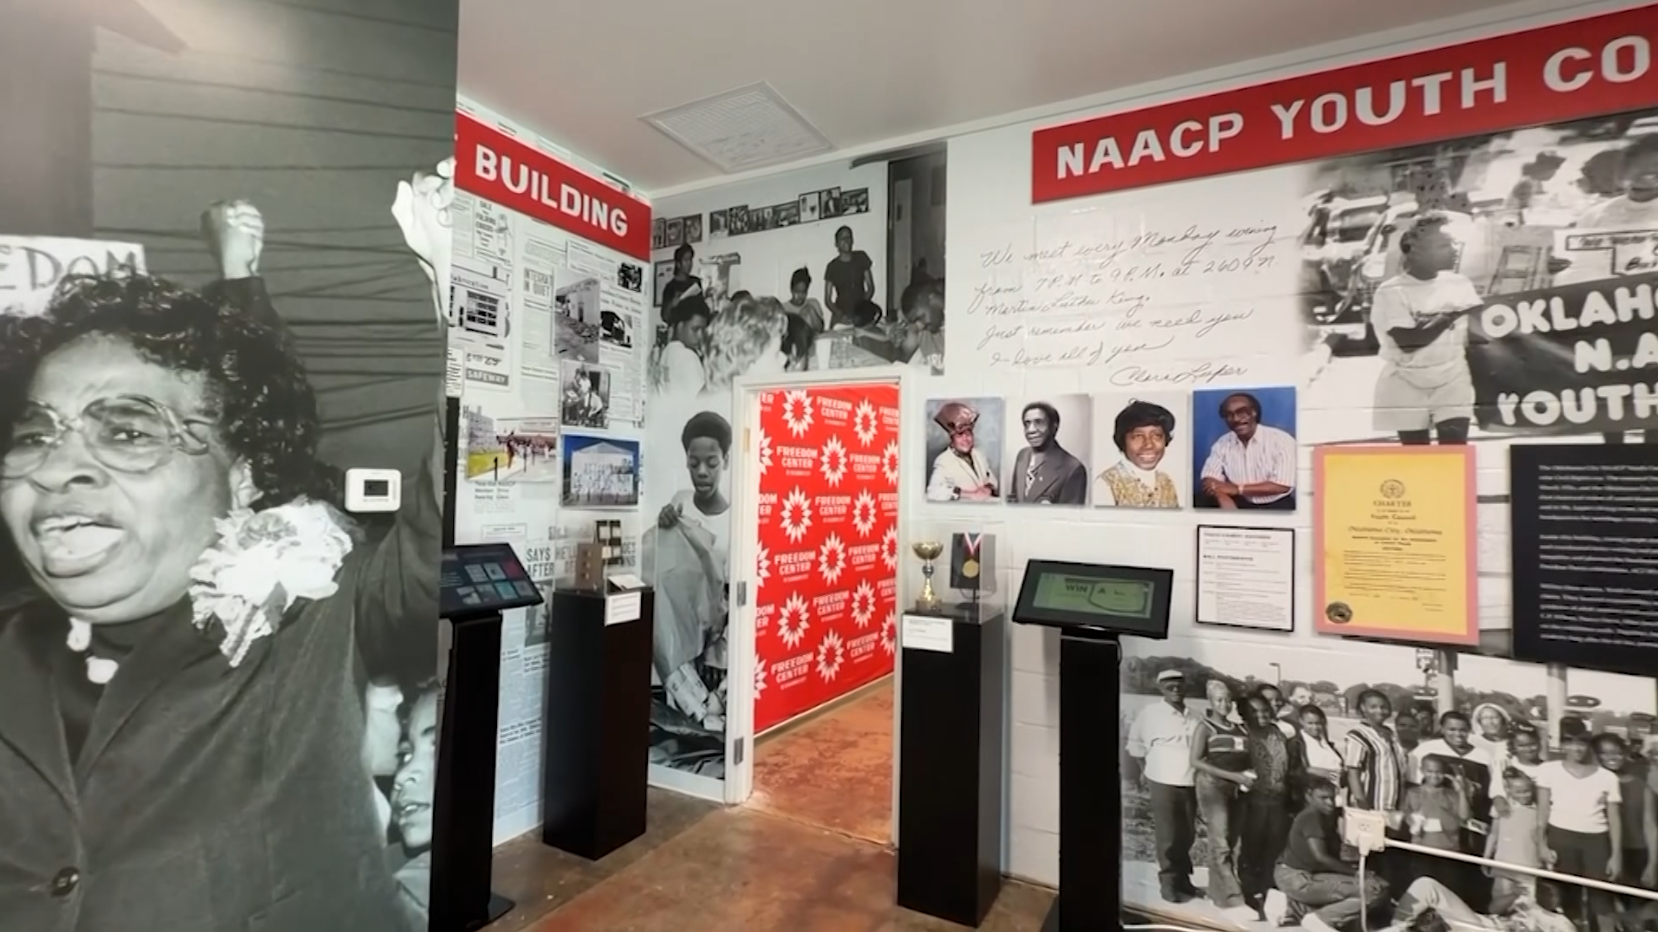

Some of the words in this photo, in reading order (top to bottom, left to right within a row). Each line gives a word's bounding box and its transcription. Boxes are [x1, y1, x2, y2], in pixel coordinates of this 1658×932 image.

[1057, 111, 1244, 180] NAACP
[1270, 61, 1507, 140] YOUTH
[1543, 35, 1652, 93] CO
[475, 143, 628, 238] BUILDING
[980, 242, 1014, 268] We
[1023, 240, 1073, 262] meet
[1073, 240, 1128, 269] every
[1130, 224, 1221, 266] Monday
[966, 283, 1023, 315] from
[1171, 260, 1201, 278] at
[1481, 283, 1658, 338] OKLAH
[976, 324, 1023, 351] Just
[1027, 320, 1106, 336] remember
[1115, 318, 1142, 331] we
[1149, 309, 1203, 328] need
[1195, 308, 1254, 338] you
[1011, 348, 1053, 366] love
[1058, 346, 1088, 360] all
[1086, 340, 1104, 366] of
[1104, 335, 1175, 364] you
[467, 371, 507, 384] SAFEWAY
[817, 396, 852, 411] FREEDOM
[1498, 382, 1658, 426] YOUTH
[821, 407, 848, 420] CENTER
[776, 446, 818, 458] FREEDOM
[849, 453, 881, 465] FREEDOM
[781, 456, 813, 469] CENTER
[853, 463, 877, 474] CENTER
[815, 495, 851, 506] FREEDOM
[819, 504, 847, 515] CENTER
[526, 547, 551, 562] SAYS
[848, 543, 880, 557] FREEDOM
[774, 550, 816, 566] FREEDOM
[852, 553, 876, 566] CENTER
[529, 561, 555, 579] AFTER
[779, 561, 811, 576] CENTER
[1066, 584, 1088, 594] WIN
[813, 590, 850, 607] FREEDOM
[817, 601, 845, 616] CENTER
[847, 631, 879, 651] FREEDOM
[850, 642, 875, 658] CENTER
[771, 651, 815, 675] FREEDOM
[776, 664, 809, 684] CENTER
